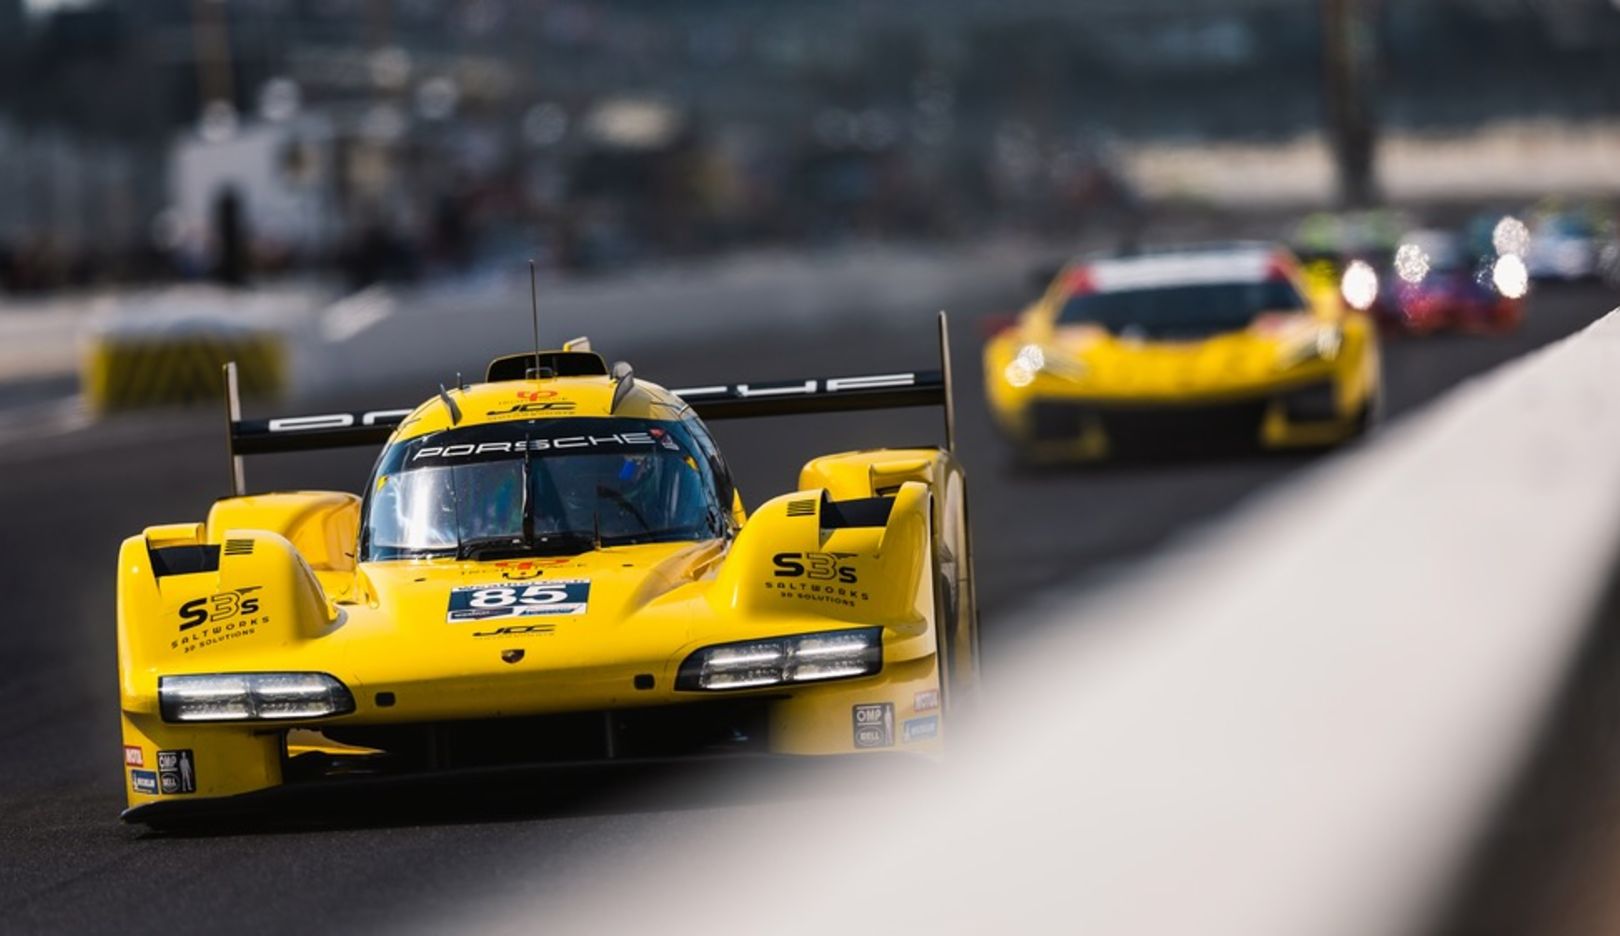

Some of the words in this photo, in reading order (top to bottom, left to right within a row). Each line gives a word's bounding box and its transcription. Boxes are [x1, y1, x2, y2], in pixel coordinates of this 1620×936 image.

[412, 432, 656, 461] PORSCHE
[469, 583, 569, 608] 85
[764, 581, 869, 601] SALTWORKS
[797, 592, 856, 608] SOLUTIONS
[170, 615, 270, 650] SALTWORKS
[199, 628, 256, 648] SOLUTIONS
[856, 708, 882, 722] OMP
[860, 731, 880, 741] BELL
[159, 755, 177, 768] OMP
